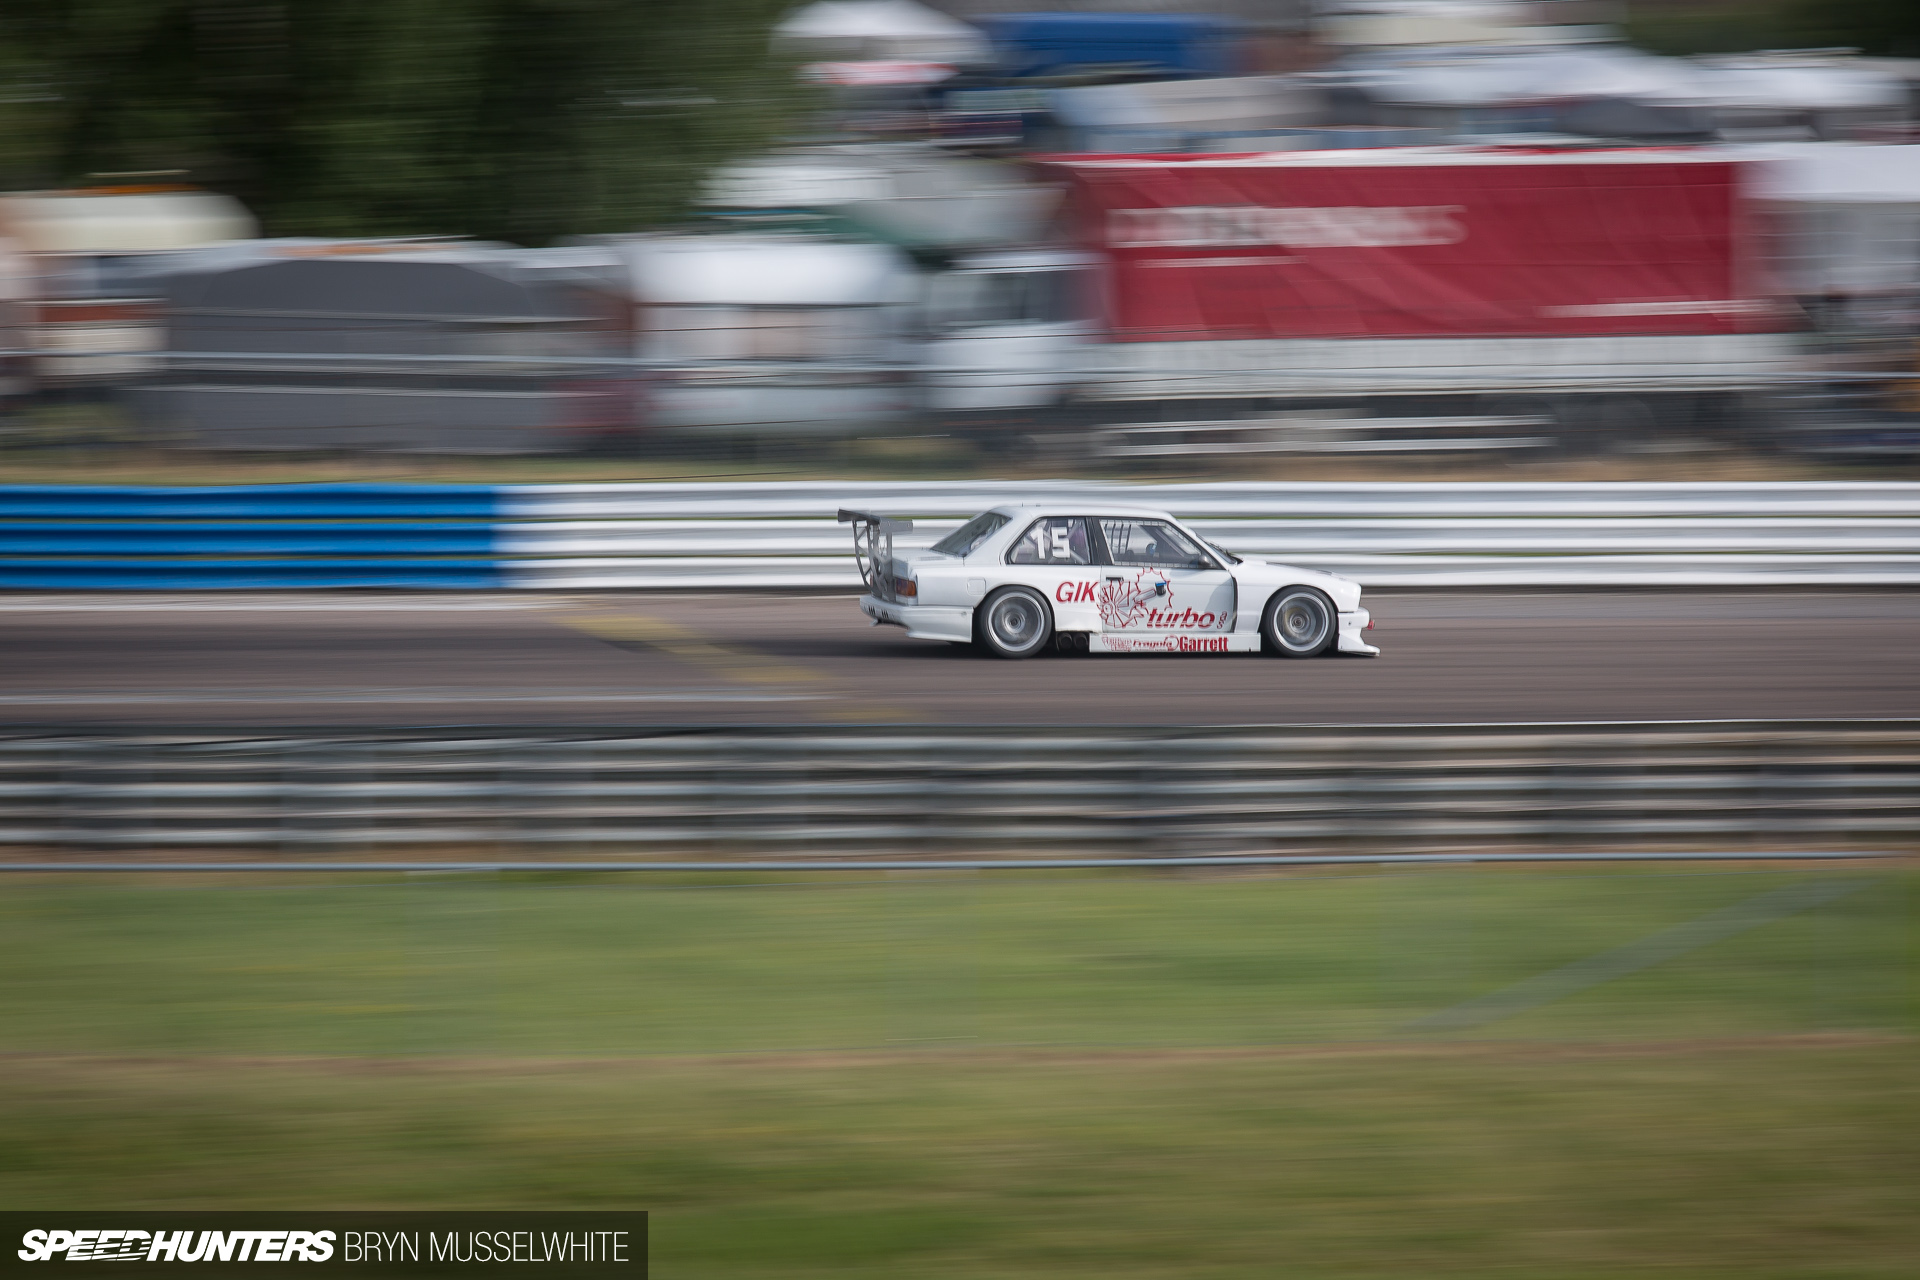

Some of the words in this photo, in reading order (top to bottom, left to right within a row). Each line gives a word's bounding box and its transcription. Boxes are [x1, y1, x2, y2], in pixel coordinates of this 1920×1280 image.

[1030, 526, 1071, 560] 15
[1055, 580, 1099, 604] GIK
[1146, 606, 1216, 629] turbo
[1179, 635, 1229, 653] Garrett
